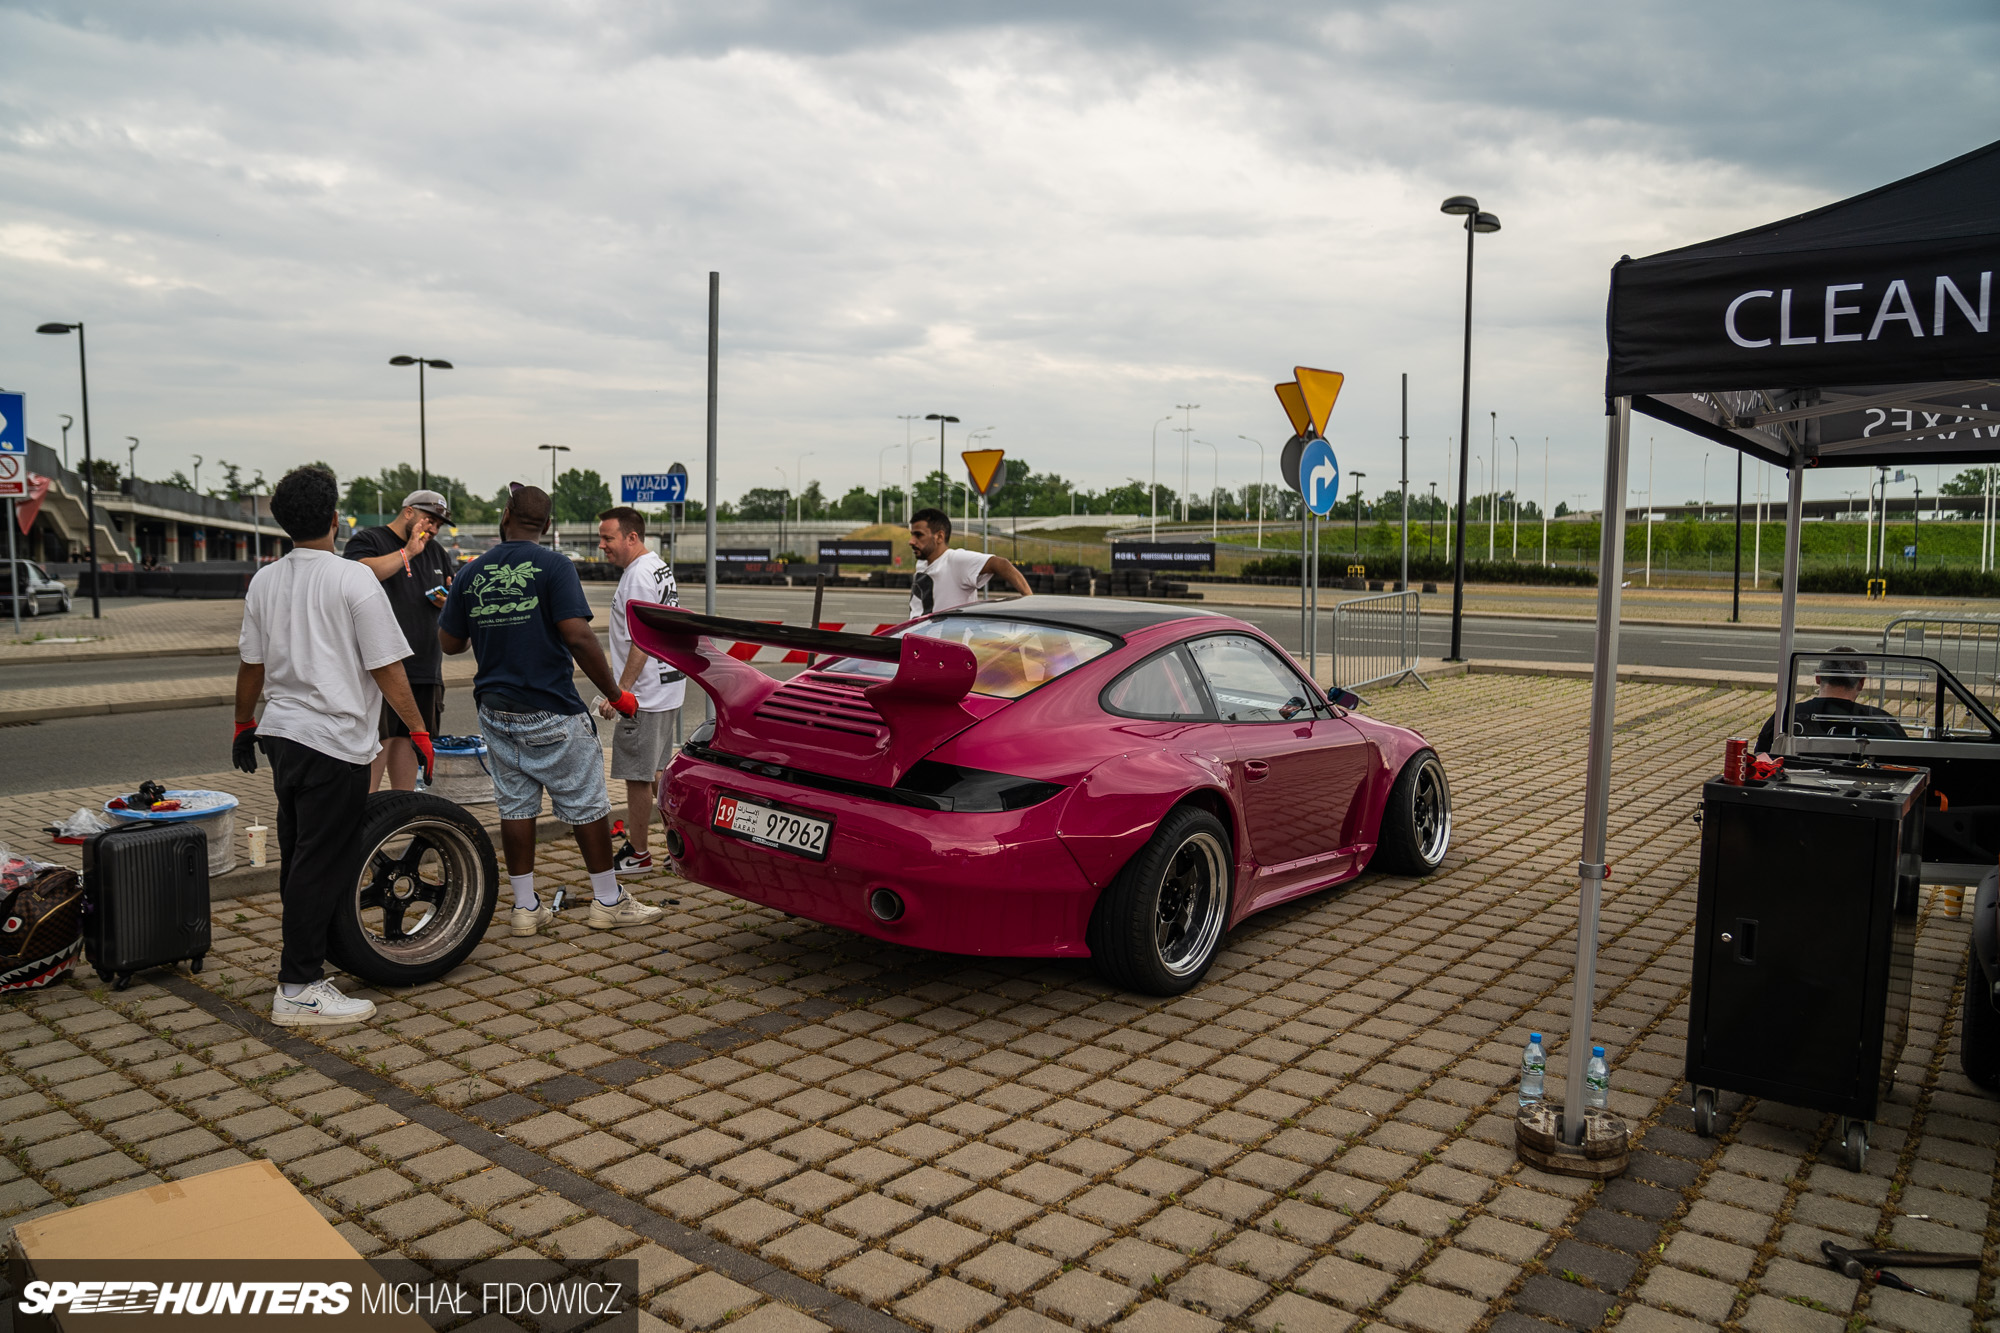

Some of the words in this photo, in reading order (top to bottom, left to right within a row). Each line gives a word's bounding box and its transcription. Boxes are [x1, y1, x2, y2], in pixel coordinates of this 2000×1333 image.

[1724, 271, 1992, 348] CLEAN
[624, 476, 669, 490] WYJAZD
[637, 491, 655, 501] EXIT
[1141, 552, 1173, 560] PROFESSIONAL
[1184, 552, 1211, 561] COSMETICS
[469, 596, 539, 617] seed
[718, 804, 735, 822] 19
[765, 813, 824, 851] 97962
